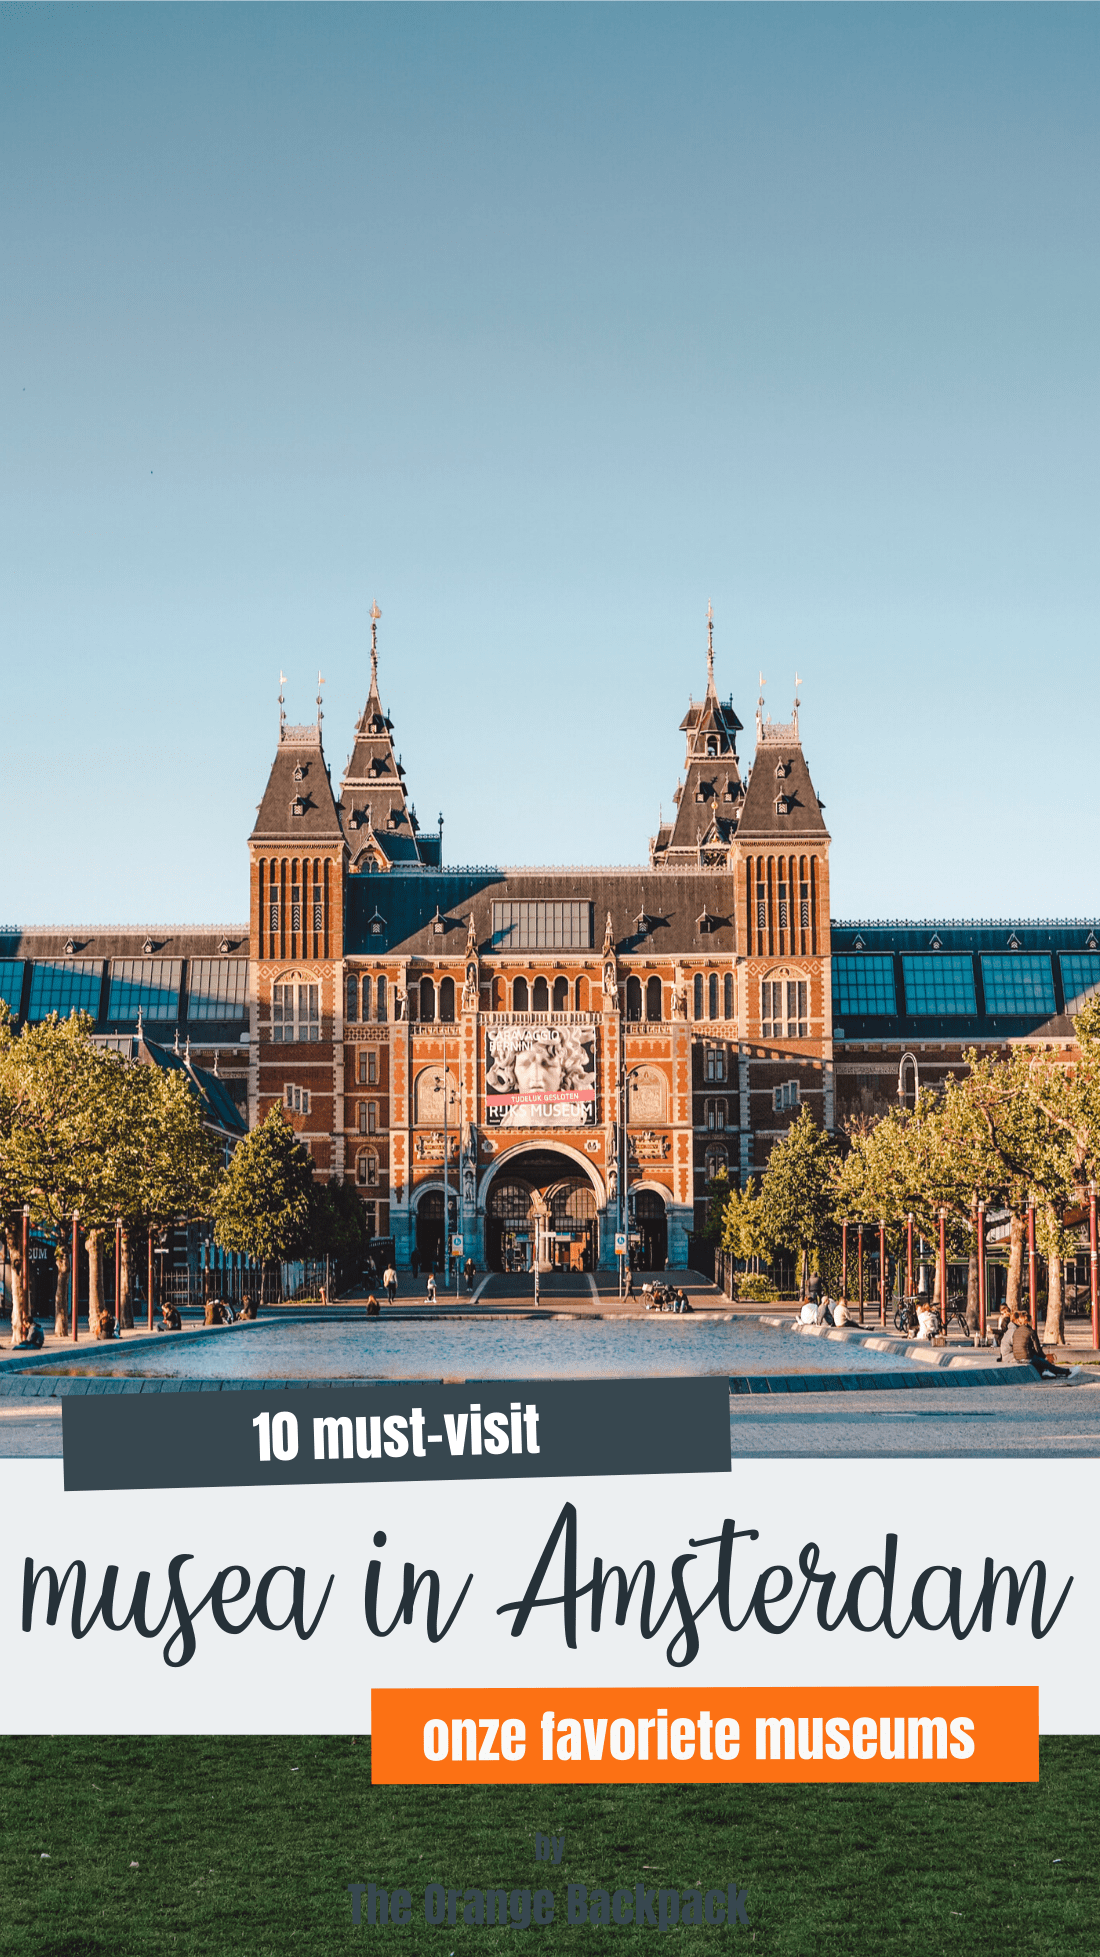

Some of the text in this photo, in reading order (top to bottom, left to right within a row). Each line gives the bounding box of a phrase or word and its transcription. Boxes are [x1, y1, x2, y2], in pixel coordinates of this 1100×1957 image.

[488, 1030, 560, 1041] CARAVAGGIO
[489, 1041, 533, 1051] BERNINI
[543, 1093, 579, 1101] GESLOTEN
[530, 1104, 593, 1117] MUSEUM
